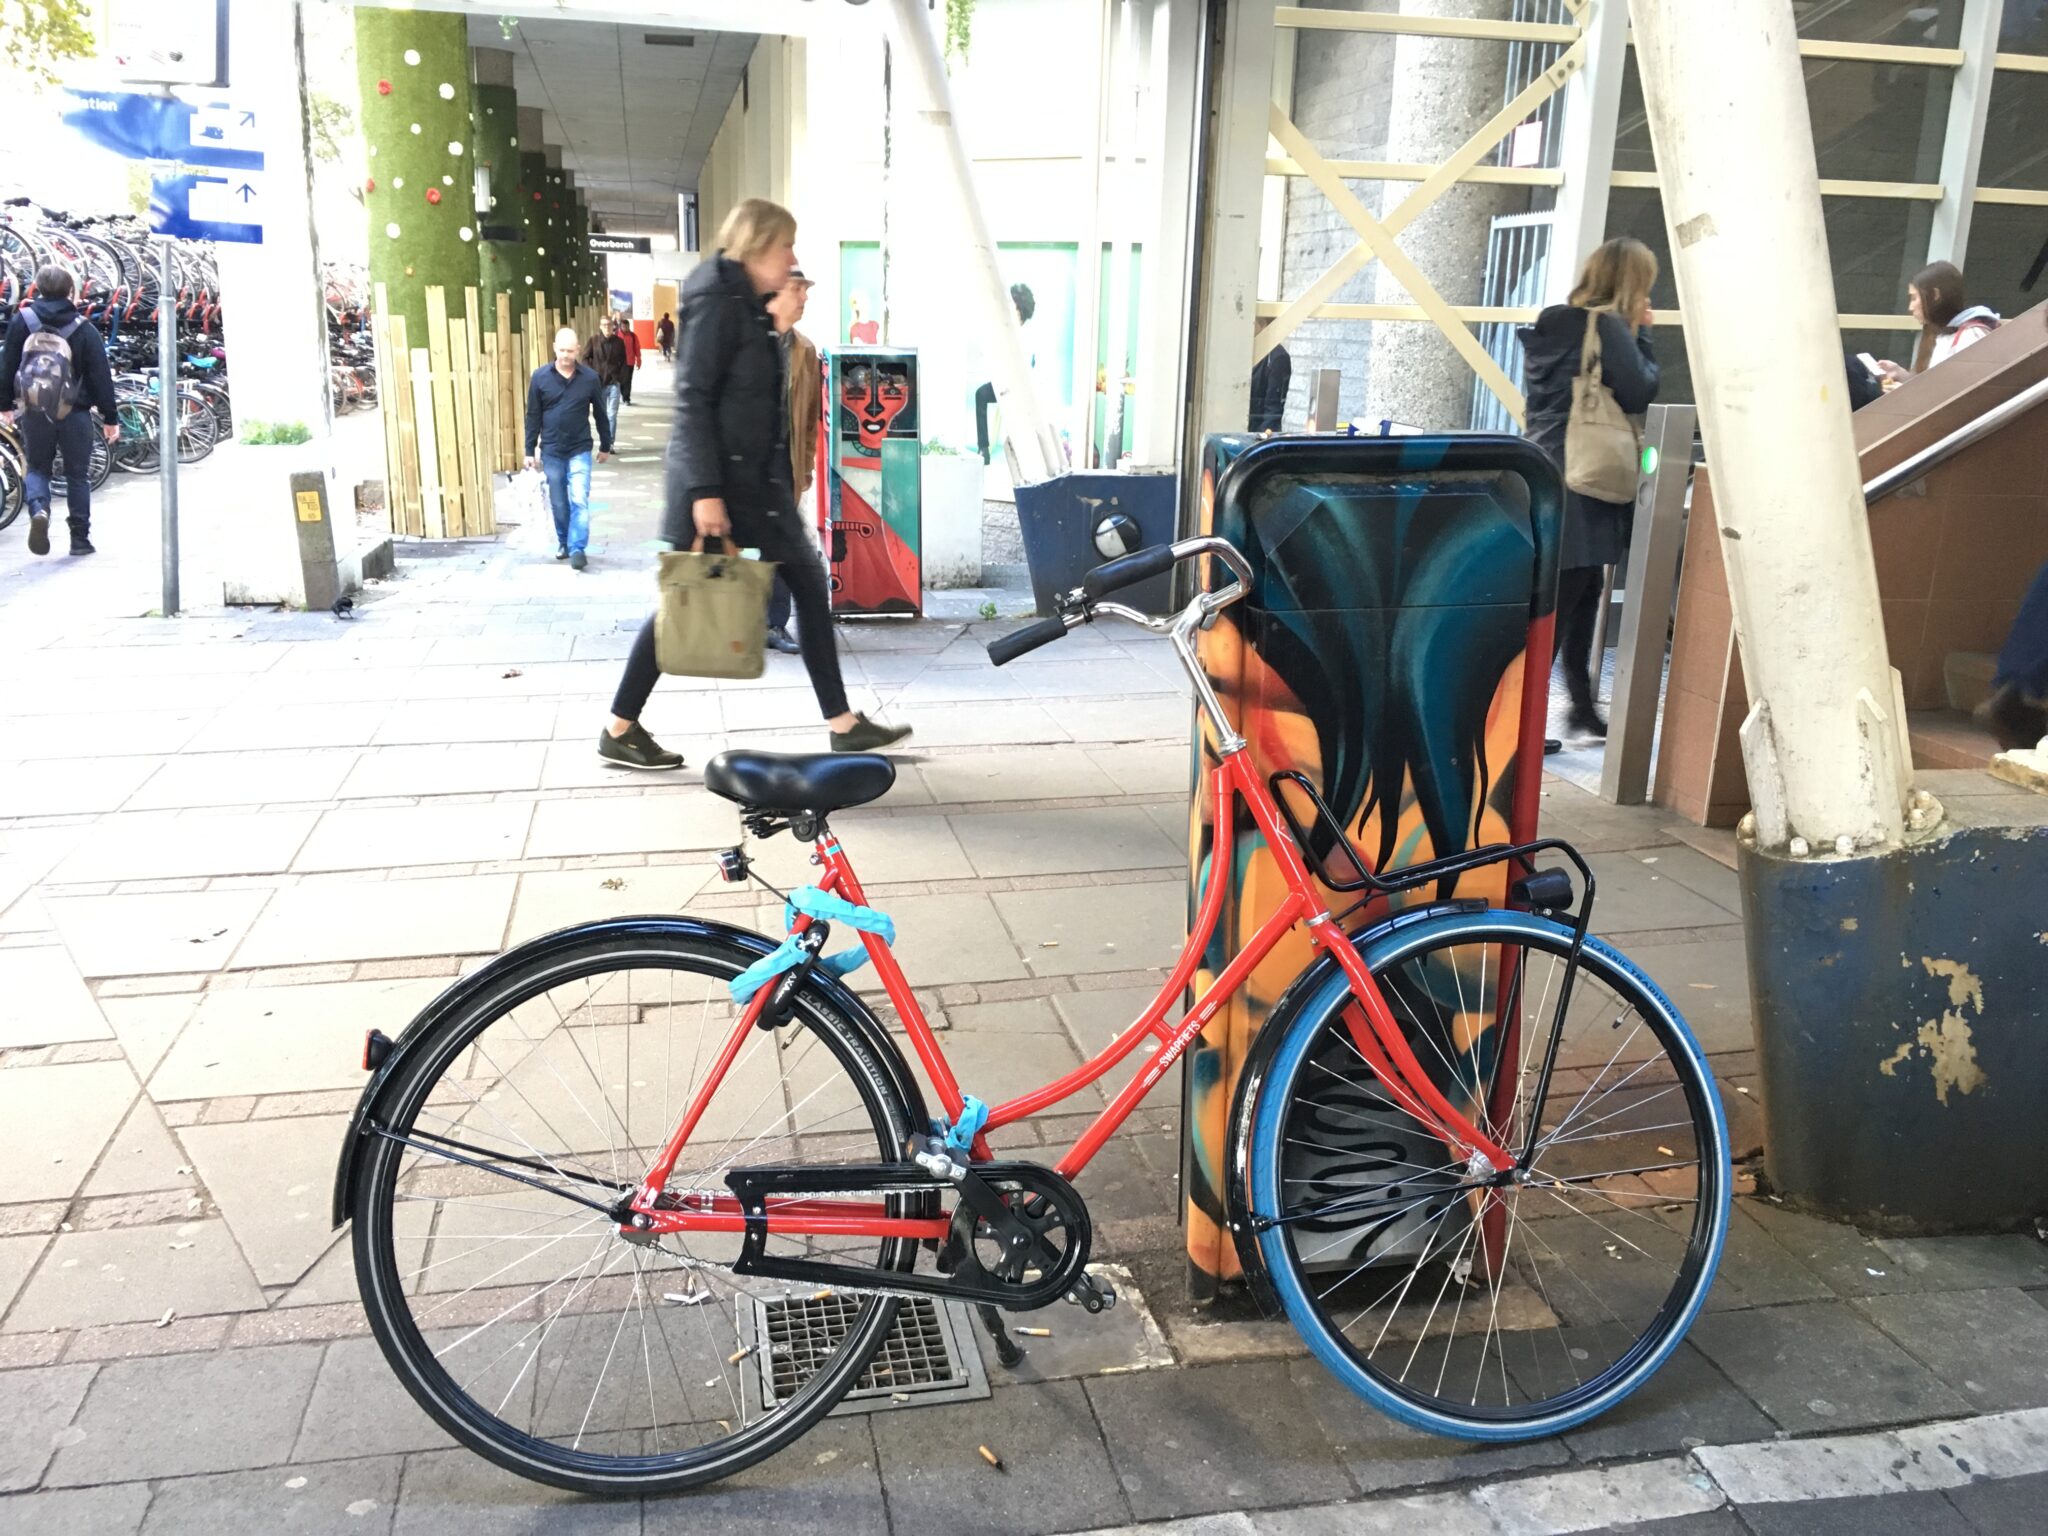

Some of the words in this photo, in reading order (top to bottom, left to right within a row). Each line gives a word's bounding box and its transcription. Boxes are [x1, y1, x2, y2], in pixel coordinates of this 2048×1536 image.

[782, 971, 797, 991] AXA
[1584, 939, 1630, 969] CLASSIC
[1631, 968, 1677, 1020] TRADITION
[800, 990, 846, 1033] CLASSIC
[845, 1031, 888, 1095] TRADITION
[1159, 1020, 1201, 1067] SWAPFIETS
